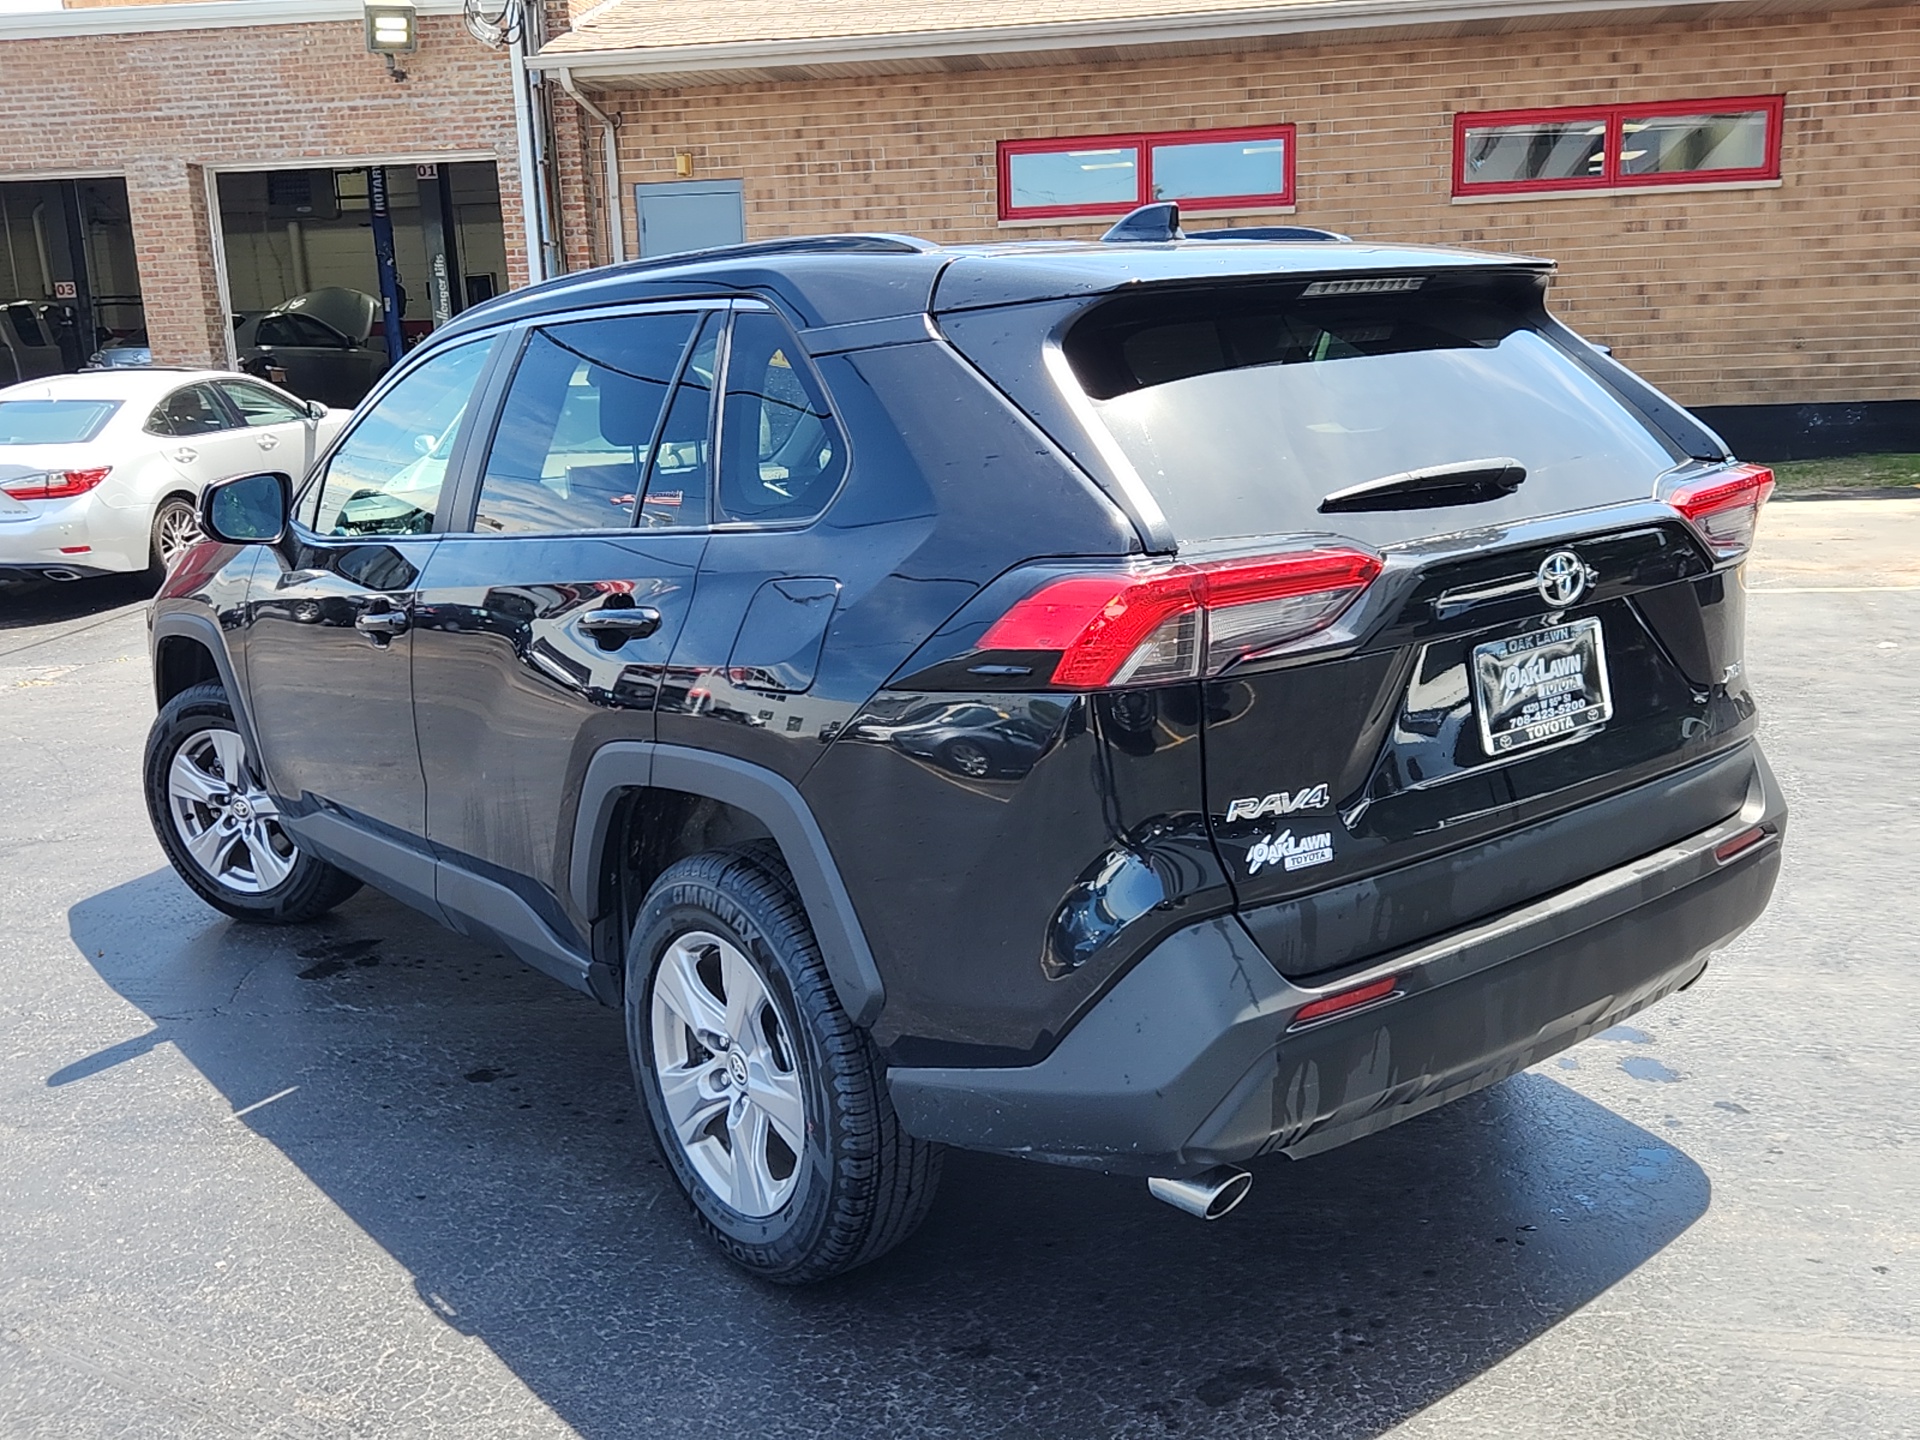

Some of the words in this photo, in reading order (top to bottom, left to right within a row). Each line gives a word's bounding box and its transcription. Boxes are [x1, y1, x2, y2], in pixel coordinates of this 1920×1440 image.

[417, 165, 437, 178] 01
[434, 253, 446, 277] Lifts
[56, 283, 75, 296] 03
[1508, 634, 1535, 653] OAK
[1535, 627, 1569, 646] LAWN
[1540, 676, 1579, 696] TOYOTA
[1509, 698, 1586, 729] 708-423-5200
[1525, 716, 1576, 740] TOYOTA
[1226, 783, 1331, 822] RAV4
[1290, 850, 1327, 867] TOYOTA
[672, 885, 761, 954] OMNIMAX
